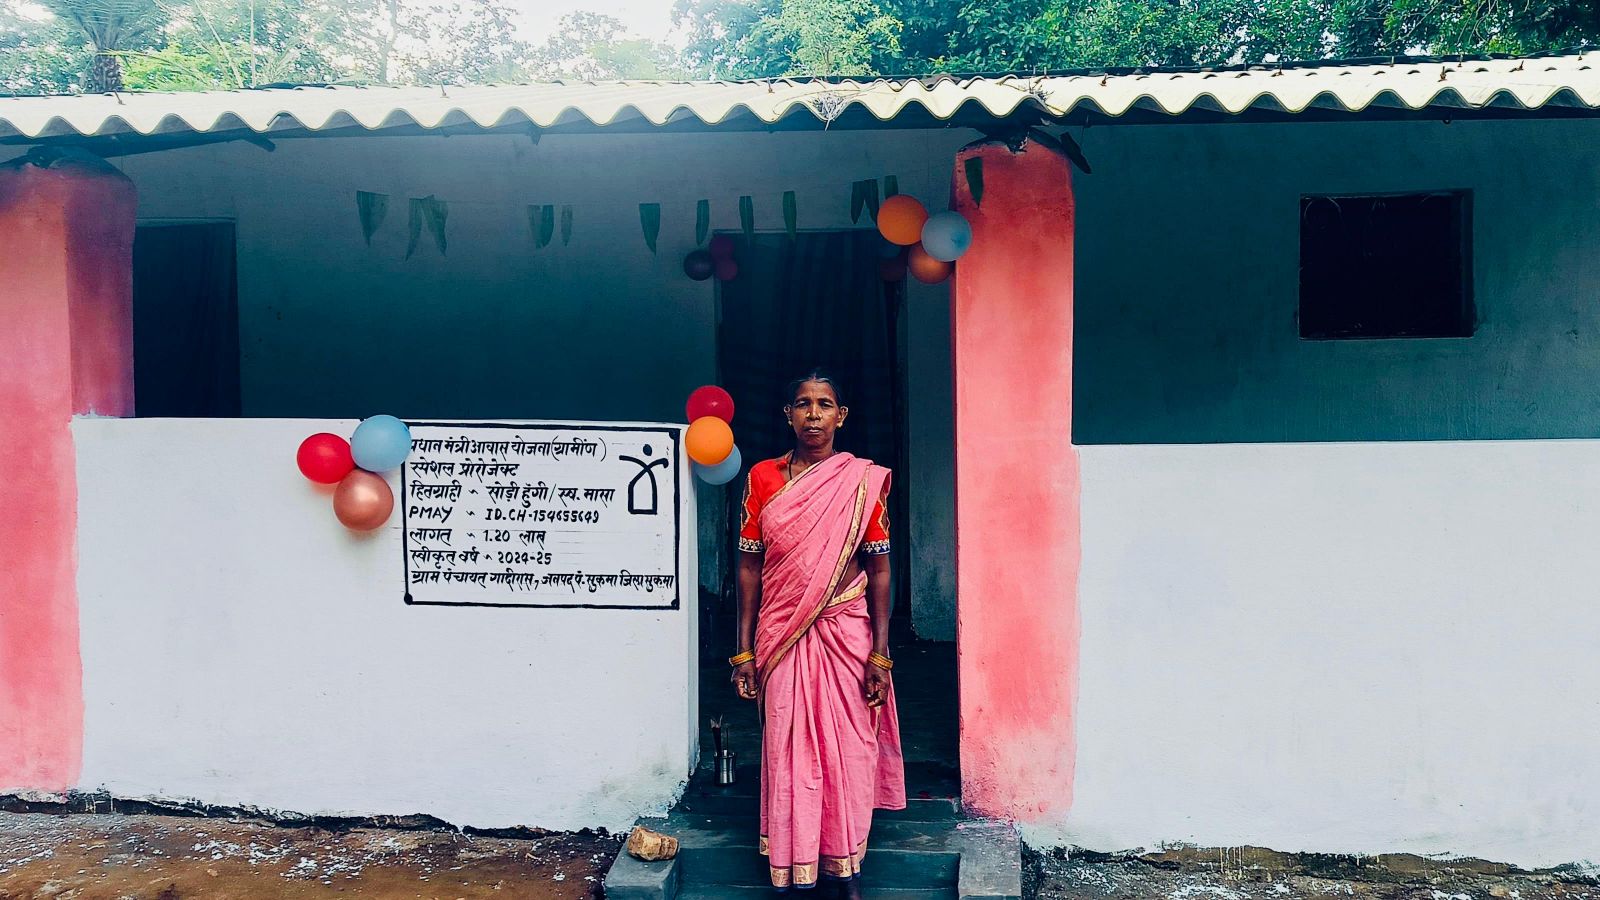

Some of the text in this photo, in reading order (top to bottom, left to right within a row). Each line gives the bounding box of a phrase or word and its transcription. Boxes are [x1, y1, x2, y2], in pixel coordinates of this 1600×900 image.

[444, 436, 470, 453] मंत्री
[470, 439, 509, 461] आवास
[511, 435, 550, 456] योजना
[410, 456, 455, 479] स्पेशल
[410, 480, 462, 502] हितग्राही
[486, 481, 520, 504] सोड़ी
[409, 505, 453, 524] PMAY
[410, 528, 452, 546] लागत
[482, 530, 510, 542] 1.20
[410, 546, 552, 569] स्वीकृत वर्ष 2024-25
[411, 570, 440, 584] ग्राम
[442, 568, 488, 589] पंचायत
[540, 573, 575, 594] जनपद
[586, 574, 618, 593] सुकमा
[620, 569, 644, 591] जिला
[644, 574, 674, 593] सुकमा
